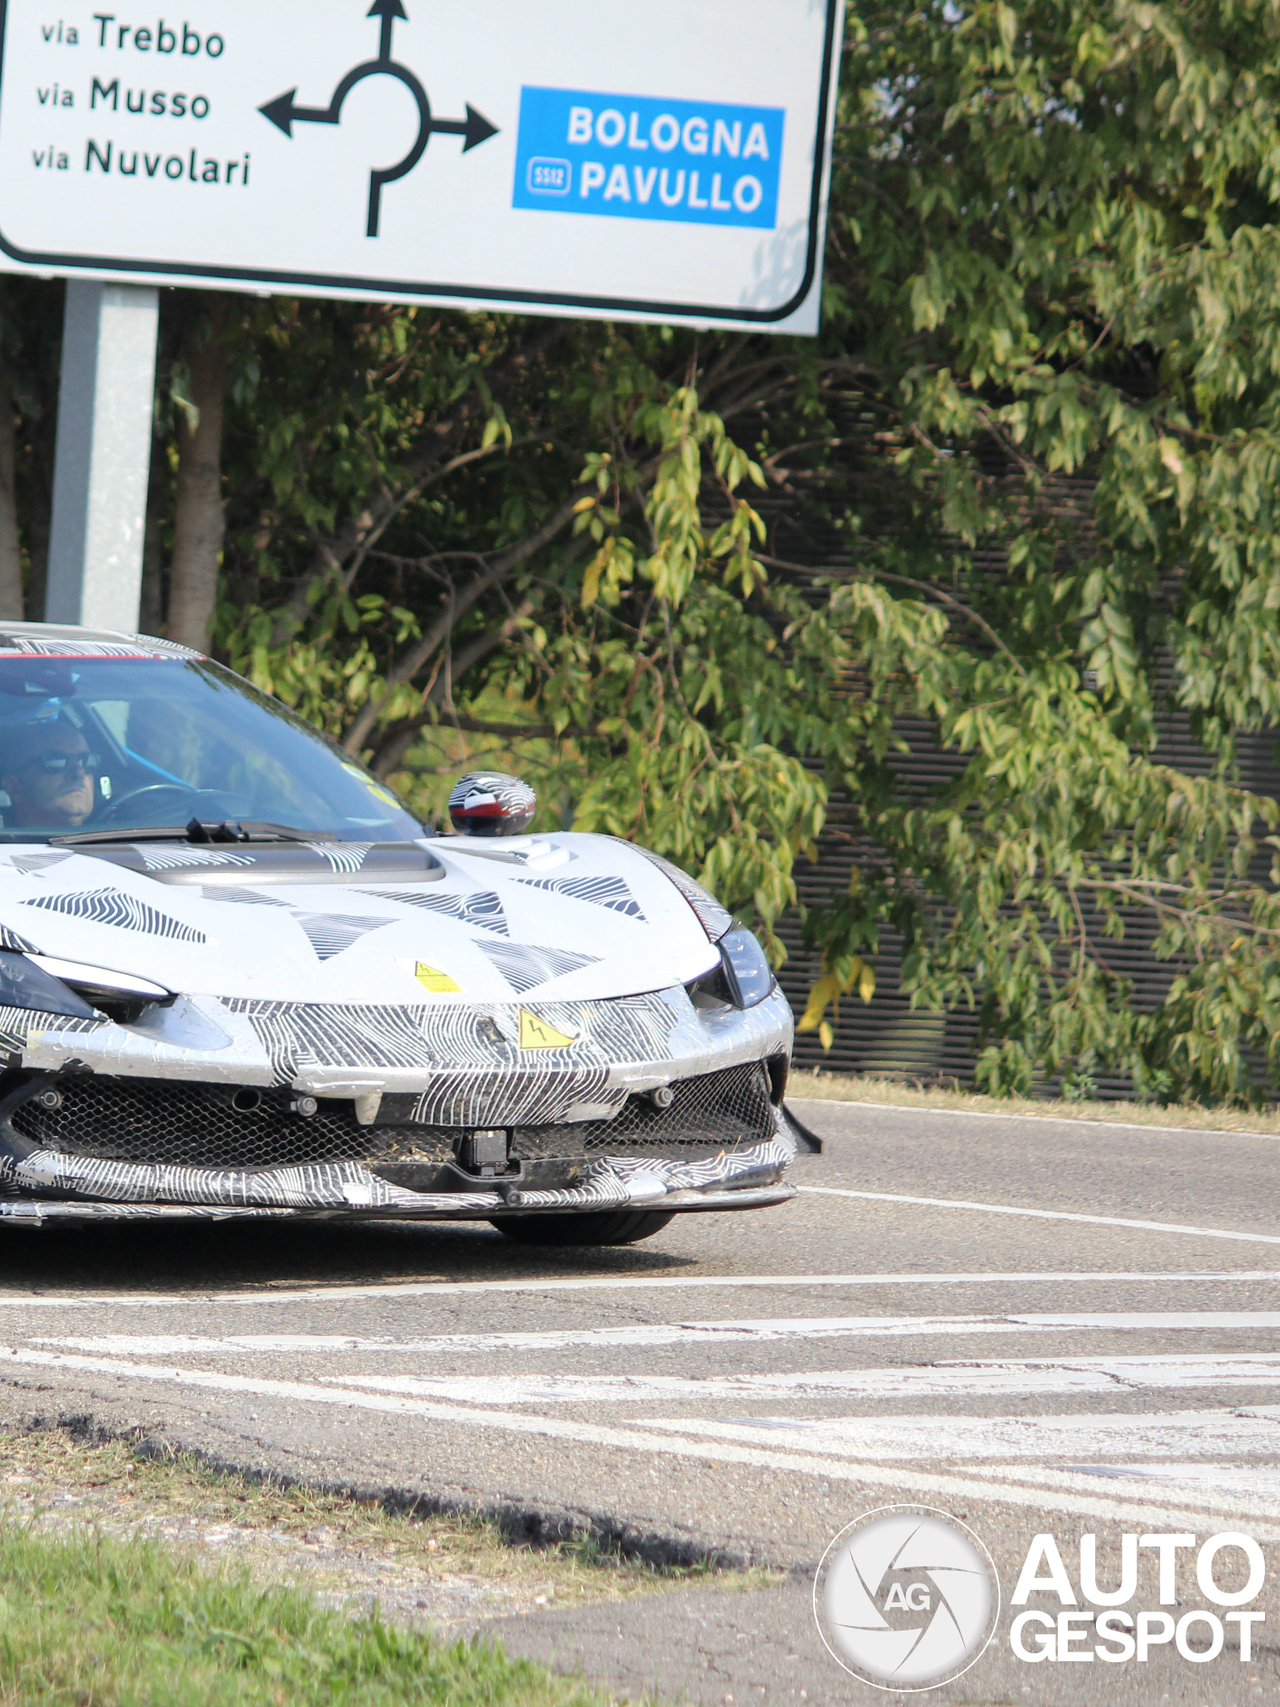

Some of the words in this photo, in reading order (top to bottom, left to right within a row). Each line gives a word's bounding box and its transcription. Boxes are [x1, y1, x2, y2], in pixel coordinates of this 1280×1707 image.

[42, 20, 79, 45] via
[93, 13, 226, 58] Trebbo
[37, 83, 74, 107] via
[90, 76, 211, 119] Musso
[568, 106, 770, 160] BOLOGNA
[32, 146, 69, 170] via
[85, 138, 250, 186] Nuvolari
[534, 166, 565, 186] SS12
[579, 161, 763, 213] PAVULLO
